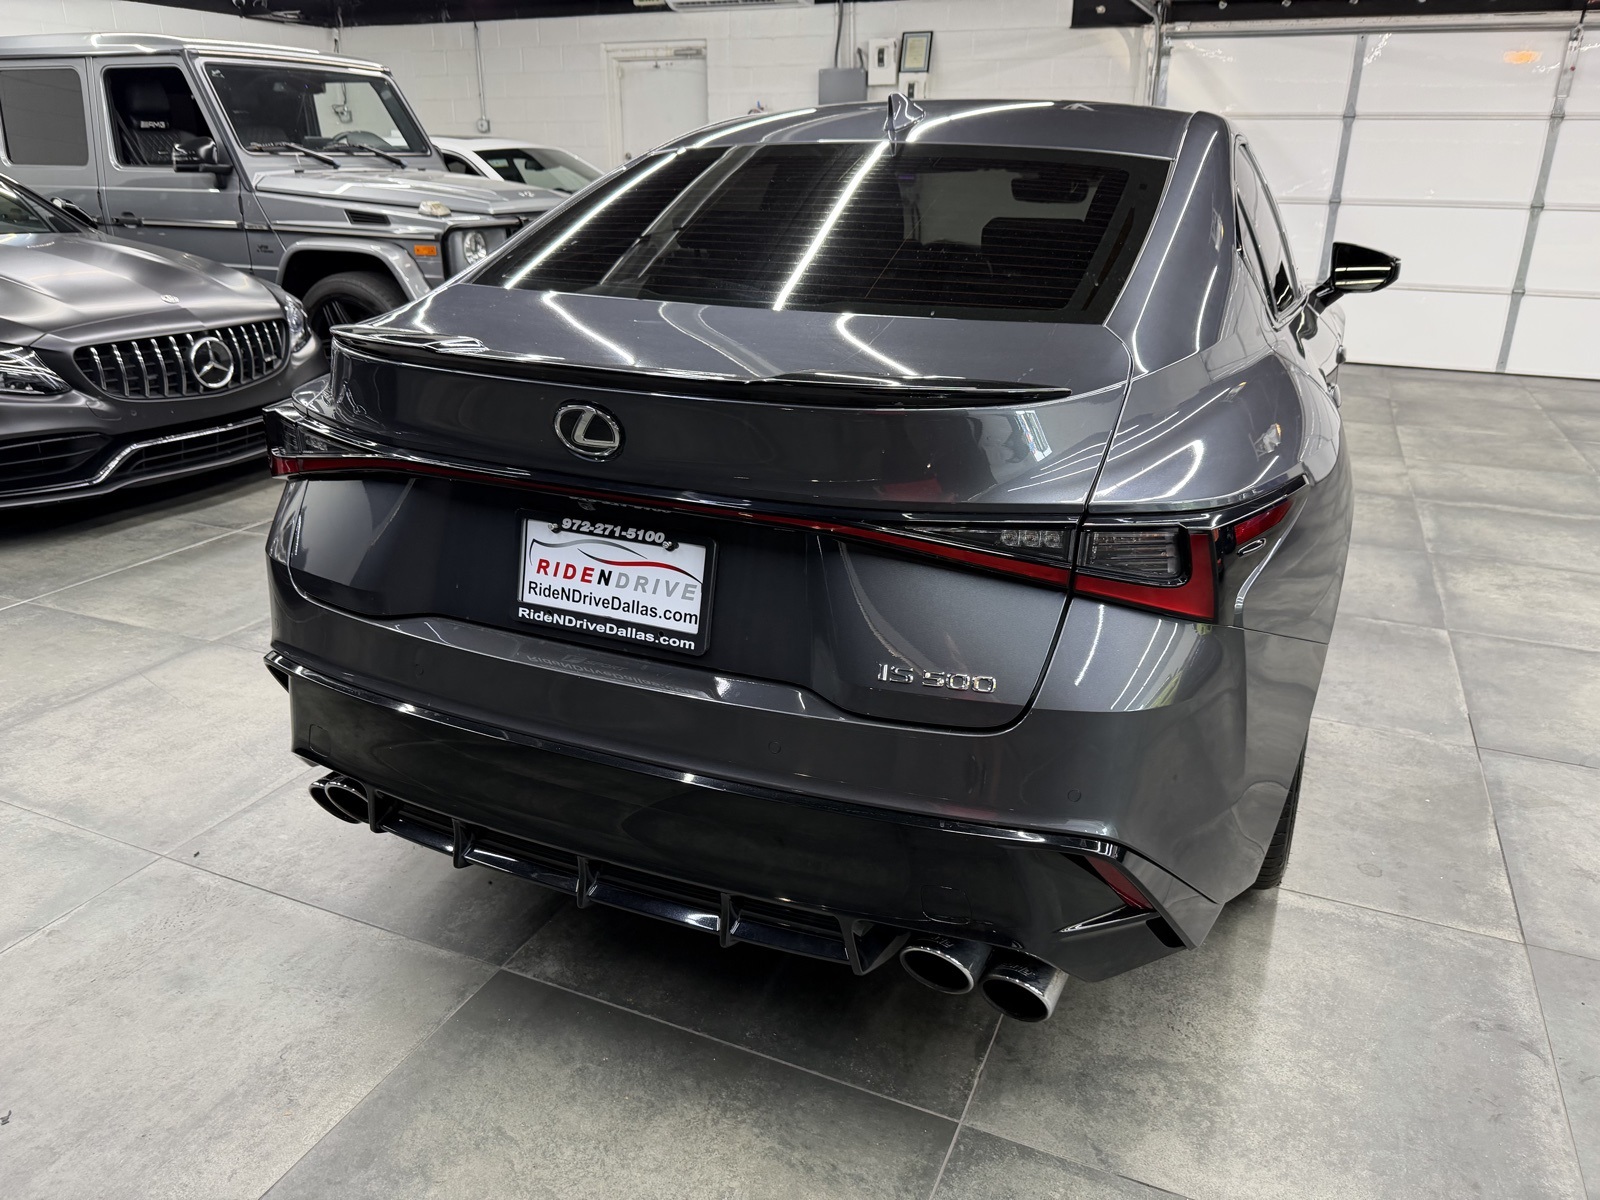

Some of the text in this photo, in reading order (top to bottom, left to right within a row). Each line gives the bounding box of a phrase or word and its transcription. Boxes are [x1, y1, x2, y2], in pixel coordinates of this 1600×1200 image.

[561, 517, 666, 544] 972-271-5100
[536, 558, 698, 601] RIDENDRIVE
[528, 580, 698, 625] RideNDriveDallas.com
[518, 607, 696, 650] RideNDriveDallas.com
[877, 663, 997, 693] IS 500
